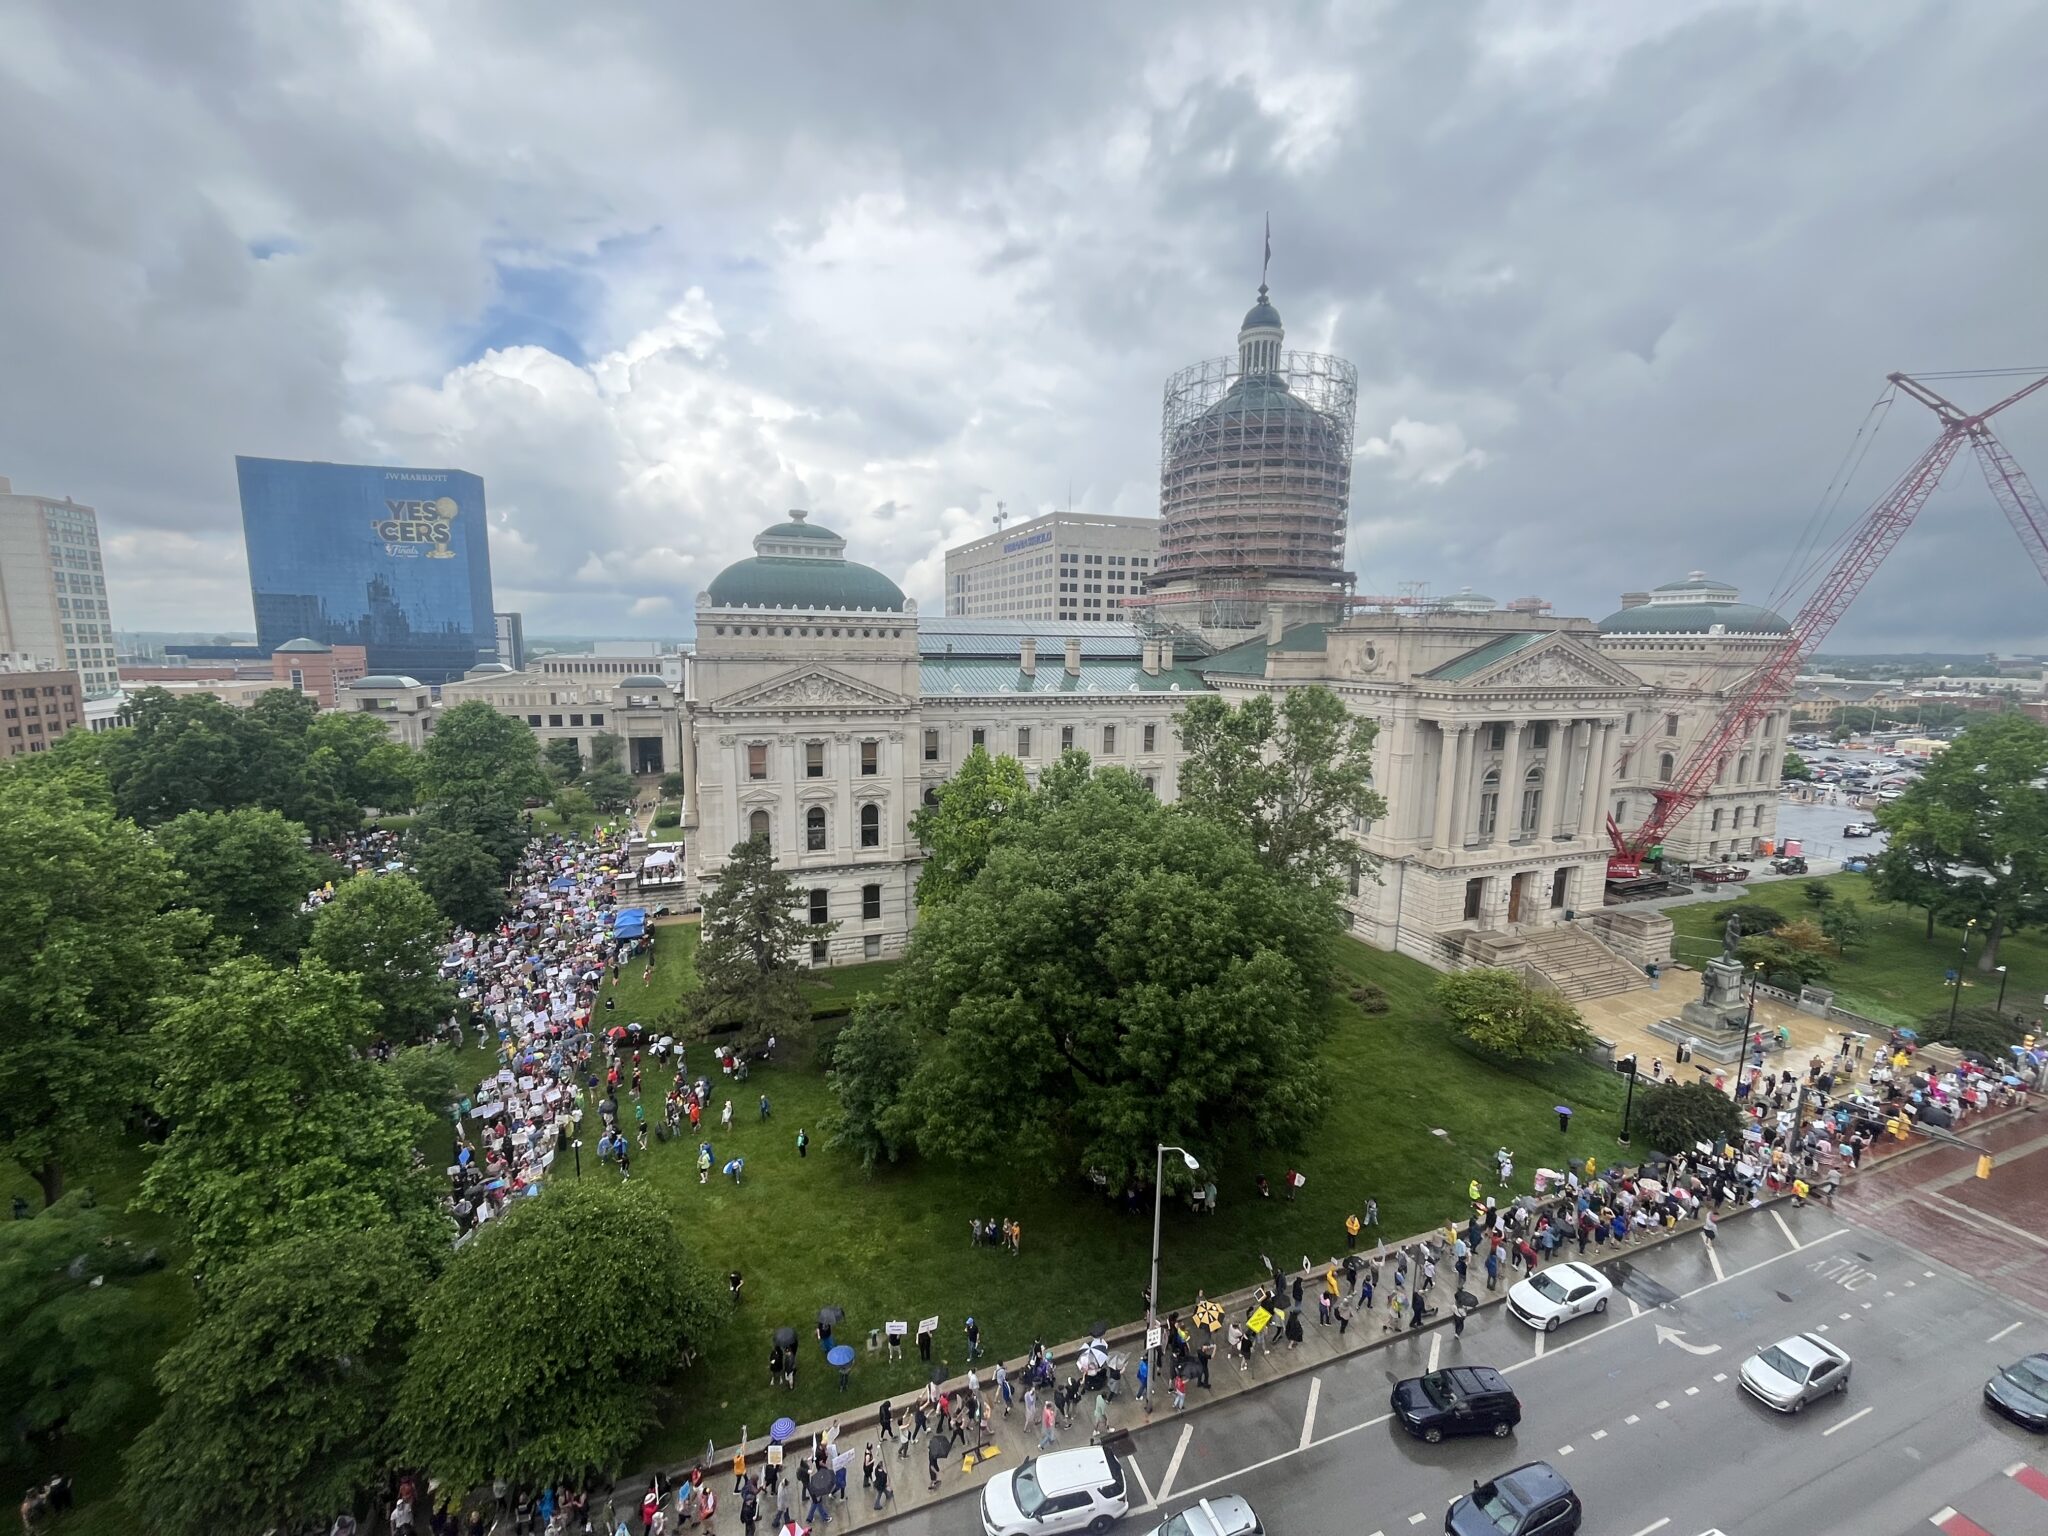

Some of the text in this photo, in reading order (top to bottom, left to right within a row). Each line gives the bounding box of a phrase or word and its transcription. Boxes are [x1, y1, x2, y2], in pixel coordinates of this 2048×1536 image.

[384, 472, 448, 482] JW MARRIOTT
[385, 500, 437, 521] YES
[1806, 1255, 1877, 1291] ONLY
